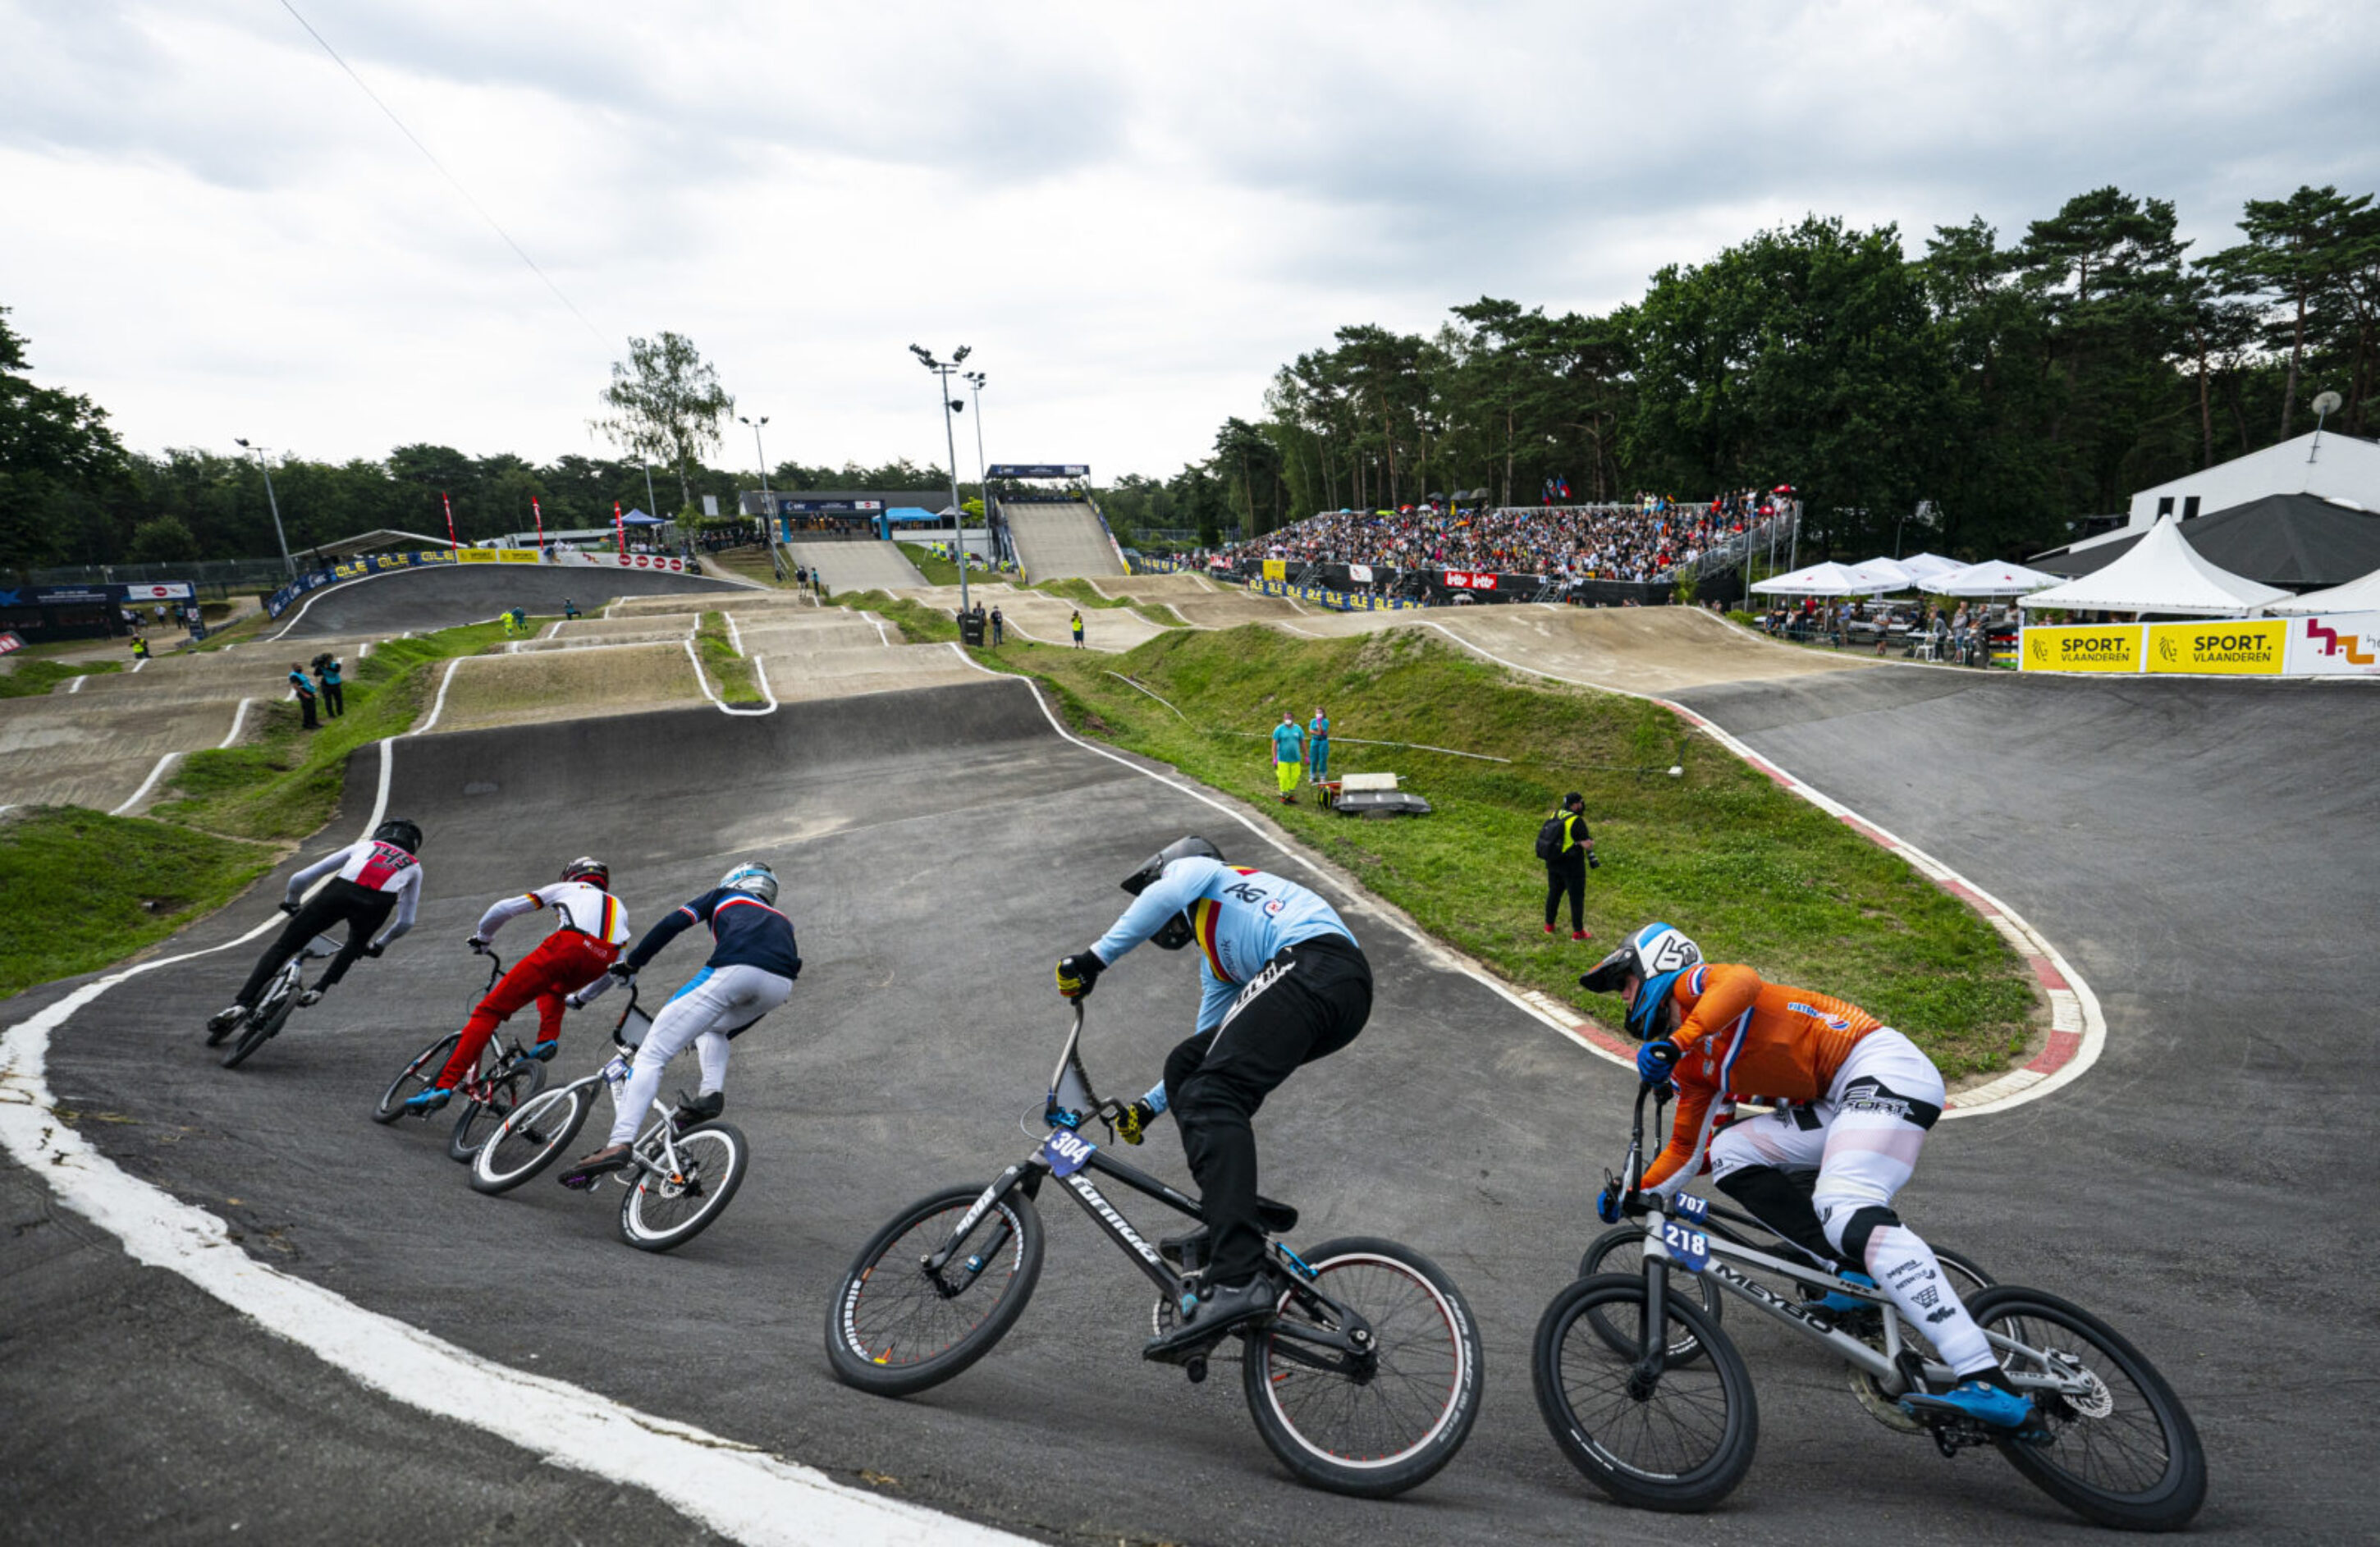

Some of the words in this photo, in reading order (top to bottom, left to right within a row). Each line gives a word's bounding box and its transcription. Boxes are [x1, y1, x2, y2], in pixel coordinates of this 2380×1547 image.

[1447, 573, 1467, 587] lotto
[1472, 574, 1494, 588] lotto
[2062, 638, 2131, 652] SPORT.
[2194, 634, 2272, 651] SPORT.
[2061, 652, 2130, 661] VLAANDEREN
[2193, 652, 2271, 662] VLAANDEREN
[367, 846, 414, 870] 149
[1223, 882, 1267, 904] AG
[1051, 1131, 1092, 1165] 304
[1679, 1192, 1705, 1215] 707
[1068, 1174, 1162, 1265] formula
[1665, 1224, 1705, 1256] 218
[1714, 1262, 1834, 1334] MEYBO
